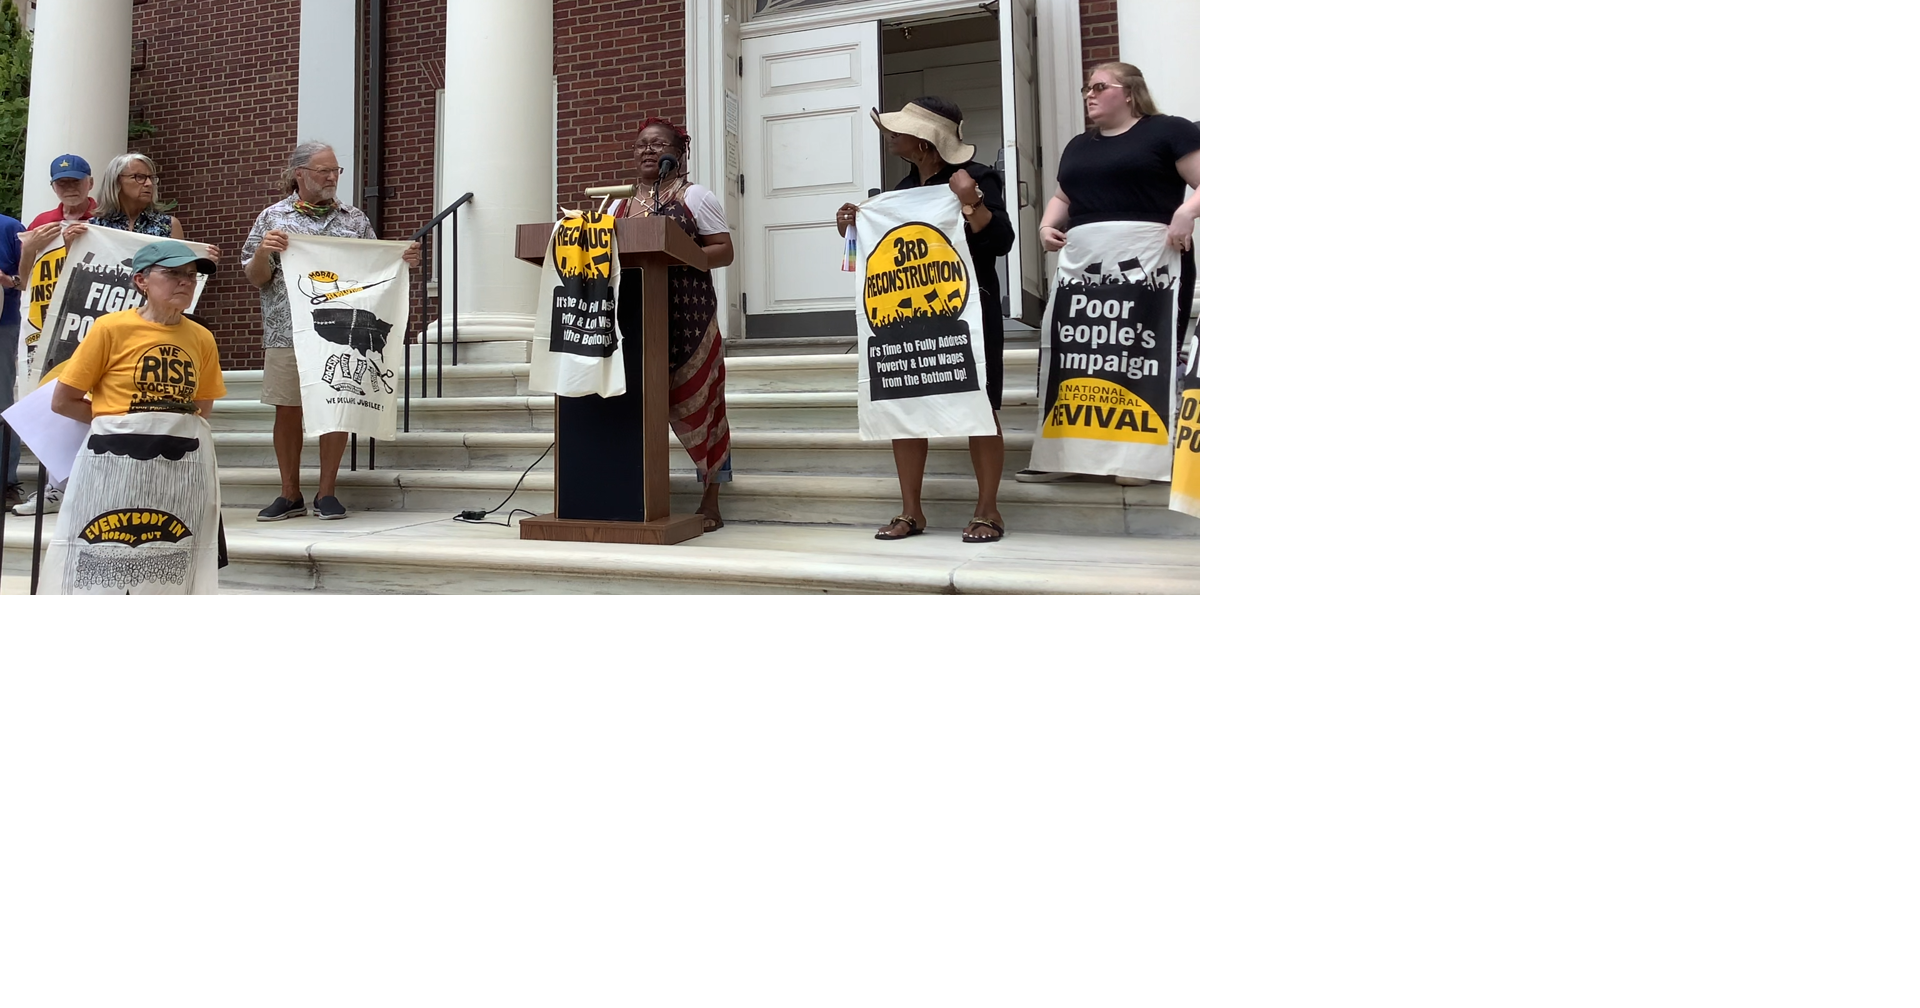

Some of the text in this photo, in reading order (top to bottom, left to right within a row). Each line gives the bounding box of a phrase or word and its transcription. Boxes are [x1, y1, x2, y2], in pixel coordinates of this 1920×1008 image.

[893, 237, 929, 268] 3RD
[308, 270, 336, 281] MORAL
[867, 260, 963, 298] RECONSTRUCTION
[84, 281, 148, 314] FIGH
[1068, 294, 1135, 319] Poor
[577, 316, 584, 328] &
[869, 334, 968, 358] It's Time to Fully Address
[1057, 320, 1156, 349] eople's
[159, 346, 180, 359] WE
[876, 352, 965, 374] Poverty & Low Wages
[140, 355, 196, 388] RISE
[323, 355, 340, 382] RACISM
[882, 367, 967, 389] from the Bottom Up!
[1065, 384, 1125, 398] NATIONAL
[1073, 393, 1096, 403] FOR
[1099, 394, 1142, 408] MORAL
[1051, 403, 1158, 434] REVIVAL
[85, 512, 185, 540] EVERYBODY IN
[101, 531, 161, 543] NOBODY OUT
